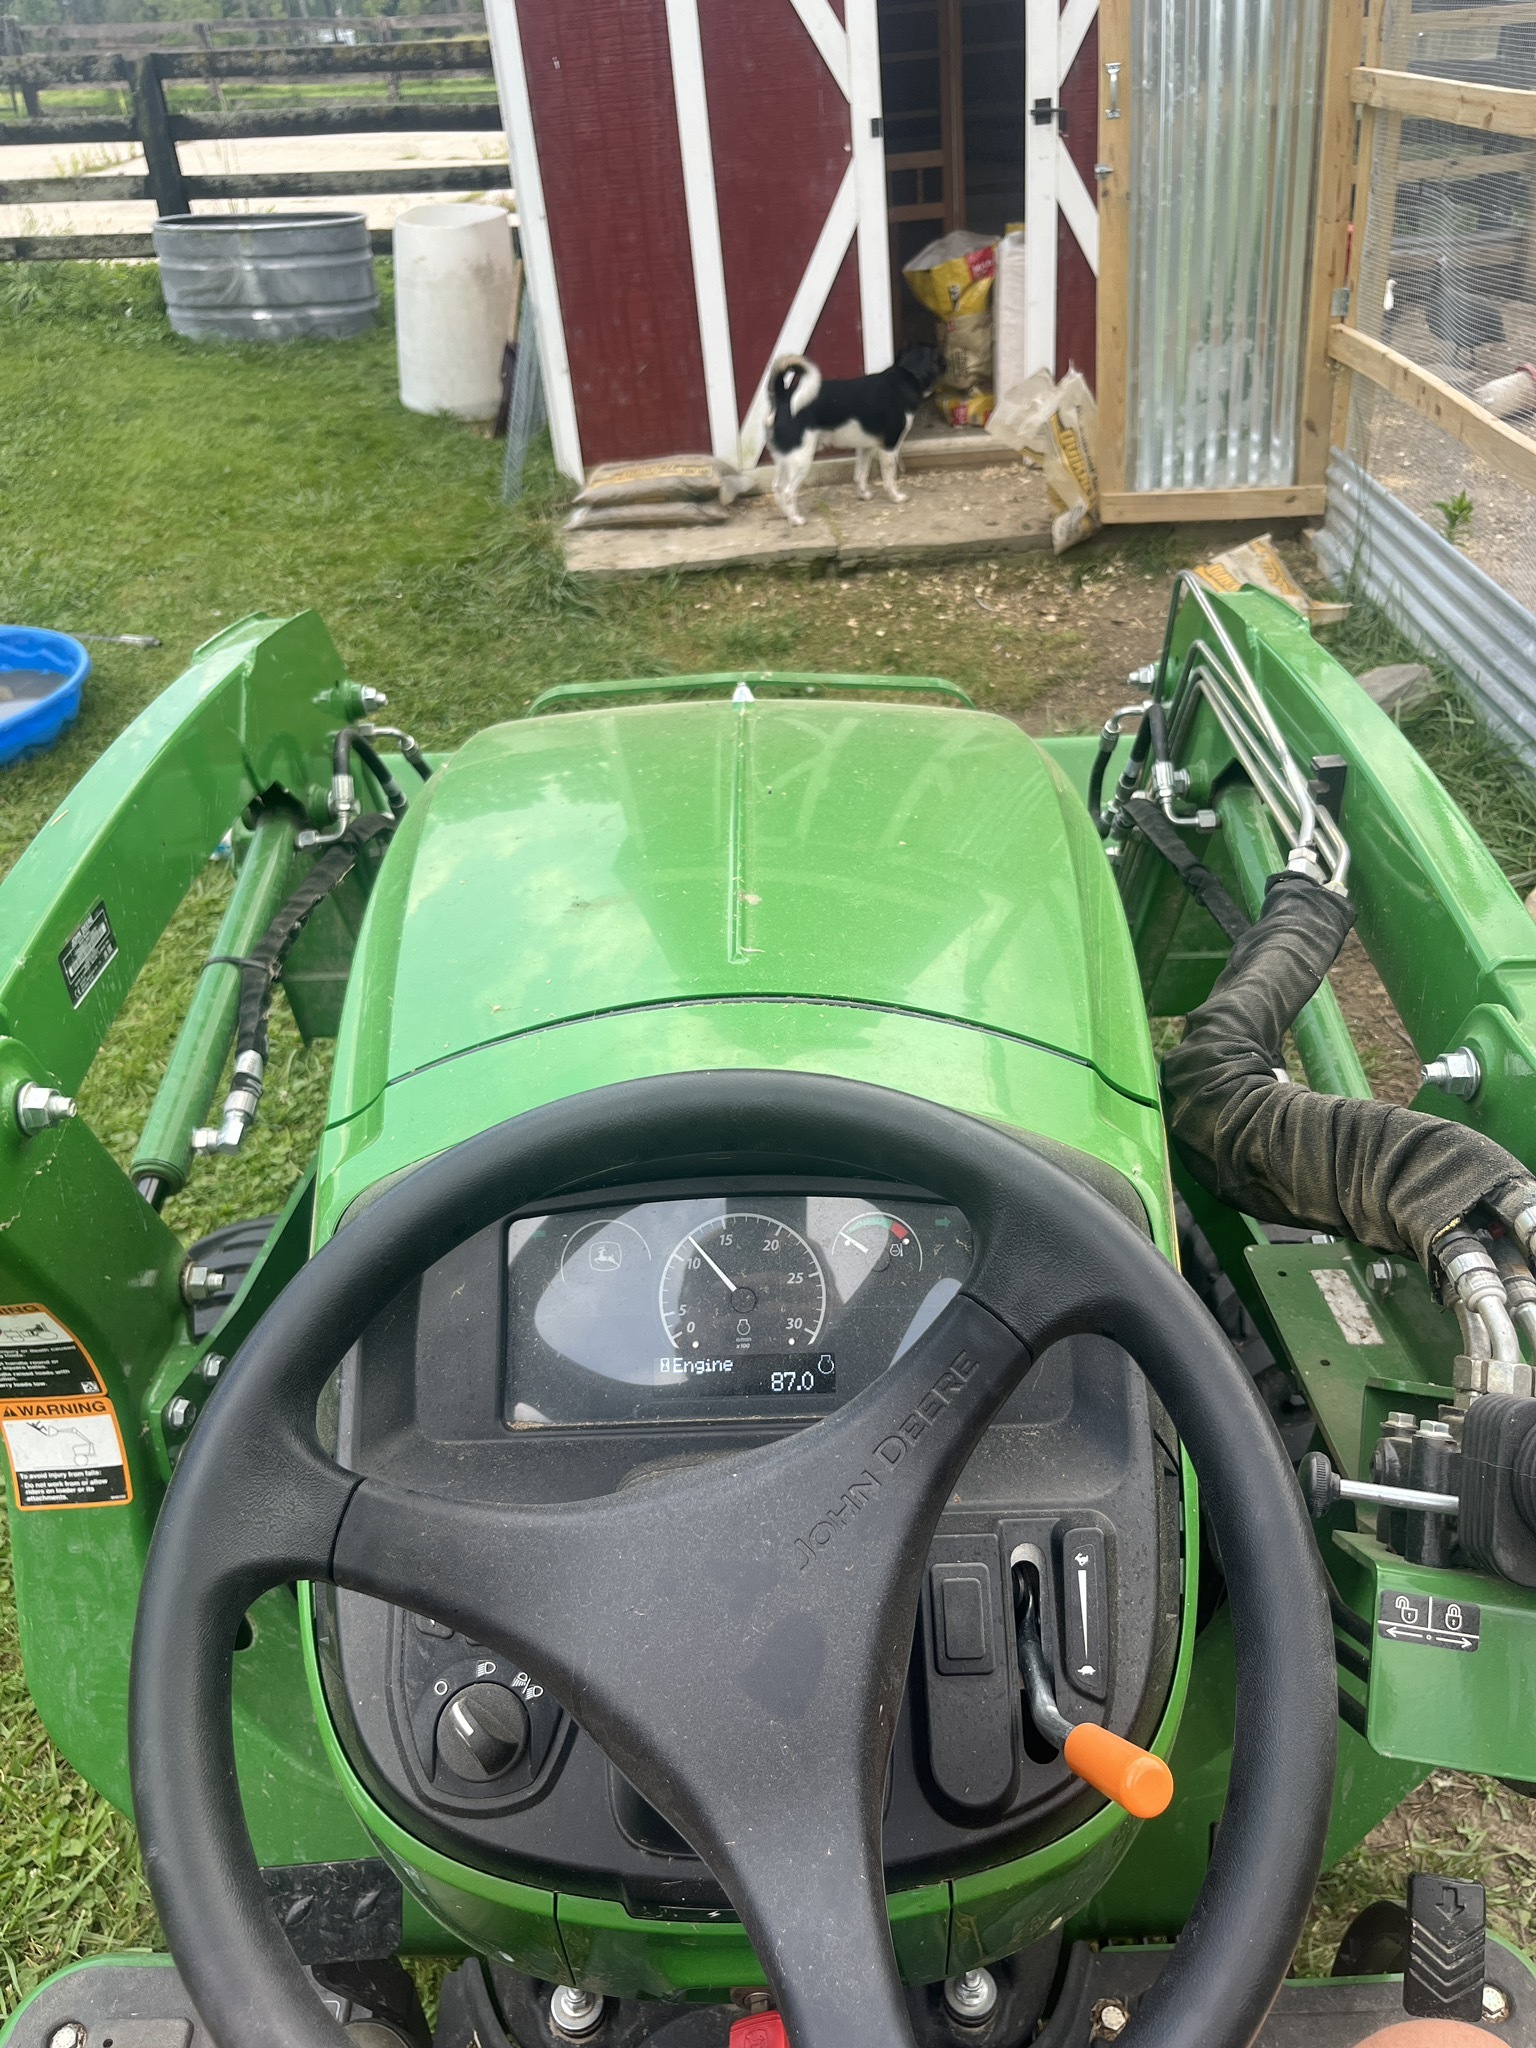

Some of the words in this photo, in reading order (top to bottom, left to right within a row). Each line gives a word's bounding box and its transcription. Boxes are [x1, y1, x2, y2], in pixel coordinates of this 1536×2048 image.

[719, 1234, 733, 1246] 15
[762, 1239, 780, 1251] 20
[686, 1258, 700, 1269] 10
[787, 1272, 804, 1284] 25
[678, 1304, 687, 1316] 5
[686, 1321, 696, 1333] 0
[786, 1318, 803, 1330] 30
[673, 1357, 734, 1374] Engine
[771, 1370, 814, 1392] 87.0
[18, 1401, 107, 1416] WARNING
[794, 1469, 883, 1570] JOHN
[872, 1350, 980, 1472] DEERE
[29, 1471, 48, 1479] avoid
[48, 1471, 67, 1480] injury
[68, 1470, 84, 1478] from
[48, 1480, 64, 1488] work
